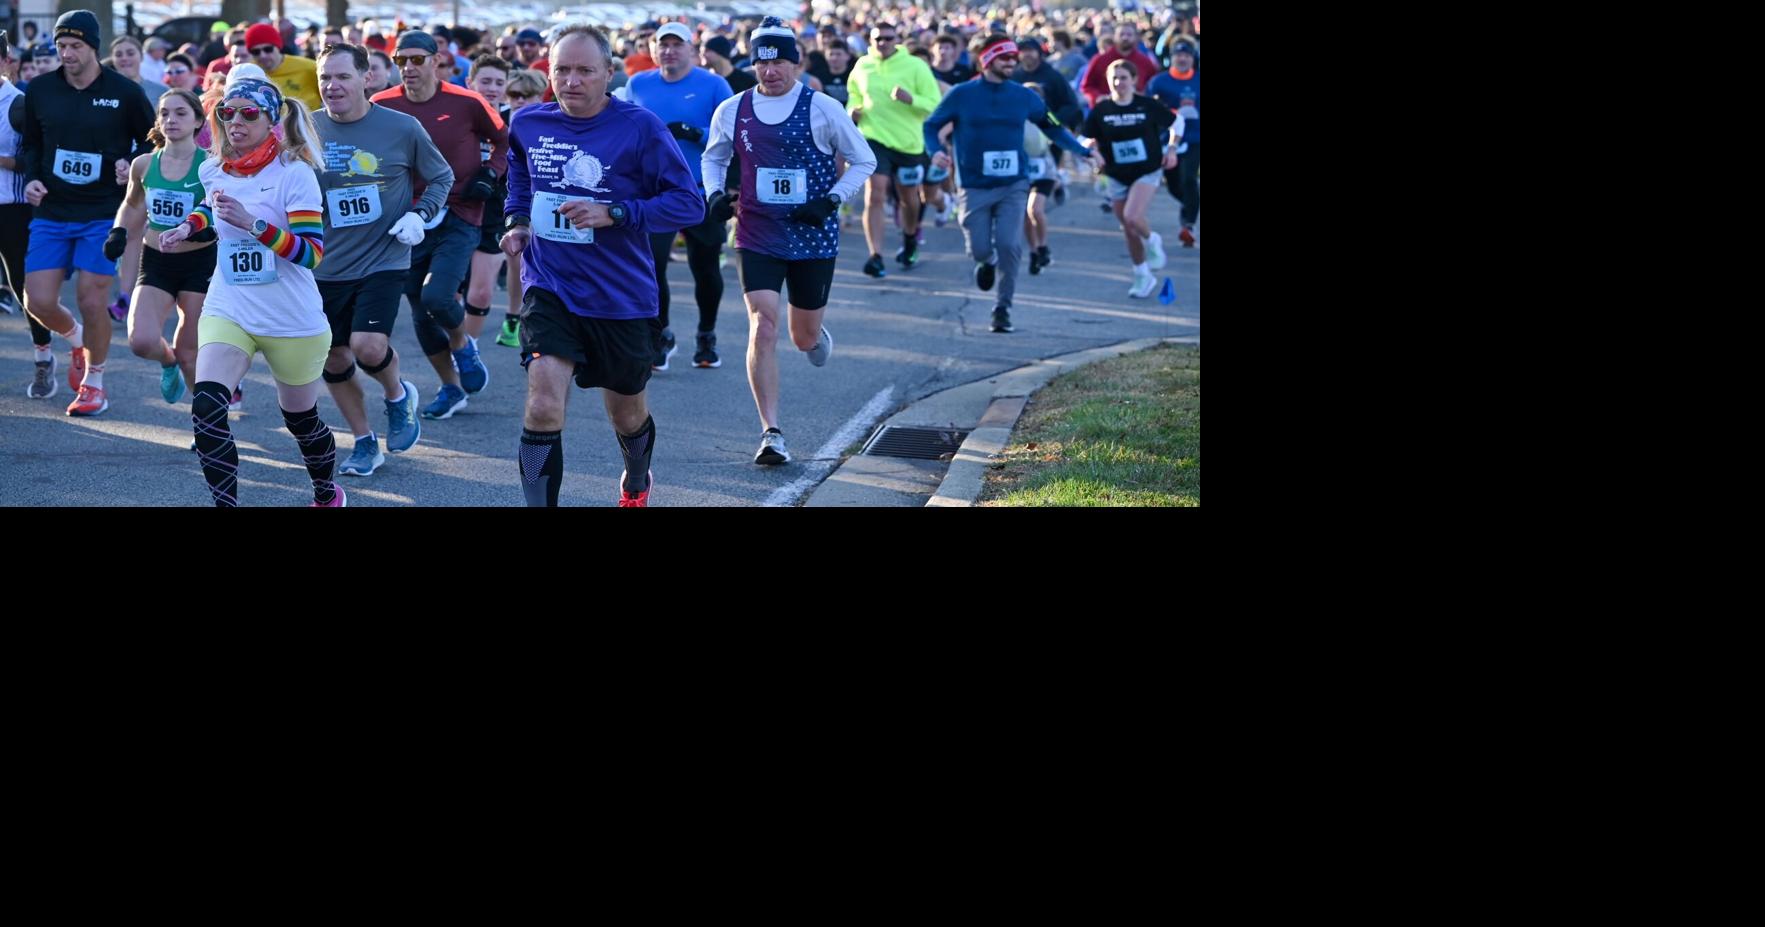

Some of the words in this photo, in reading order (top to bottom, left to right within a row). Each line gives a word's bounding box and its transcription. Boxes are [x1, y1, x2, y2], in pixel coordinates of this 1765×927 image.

[538, 135, 554, 143] Fast
[528, 146, 554, 154] Festive
[542, 142, 578, 150] Freddie's
[531, 153, 567, 162] Five-Mile
[533, 159, 551, 167] Foot
[992, 158, 1011, 170] 577
[62, 160, 92, 177] 649
[537, 165, 559, 173] Feast
[772, 179, 791, 195] 18
[152, 199, 184, 218] 556
[339, 197, 370, 217] 916
[229, 251, 263, 273] 130
